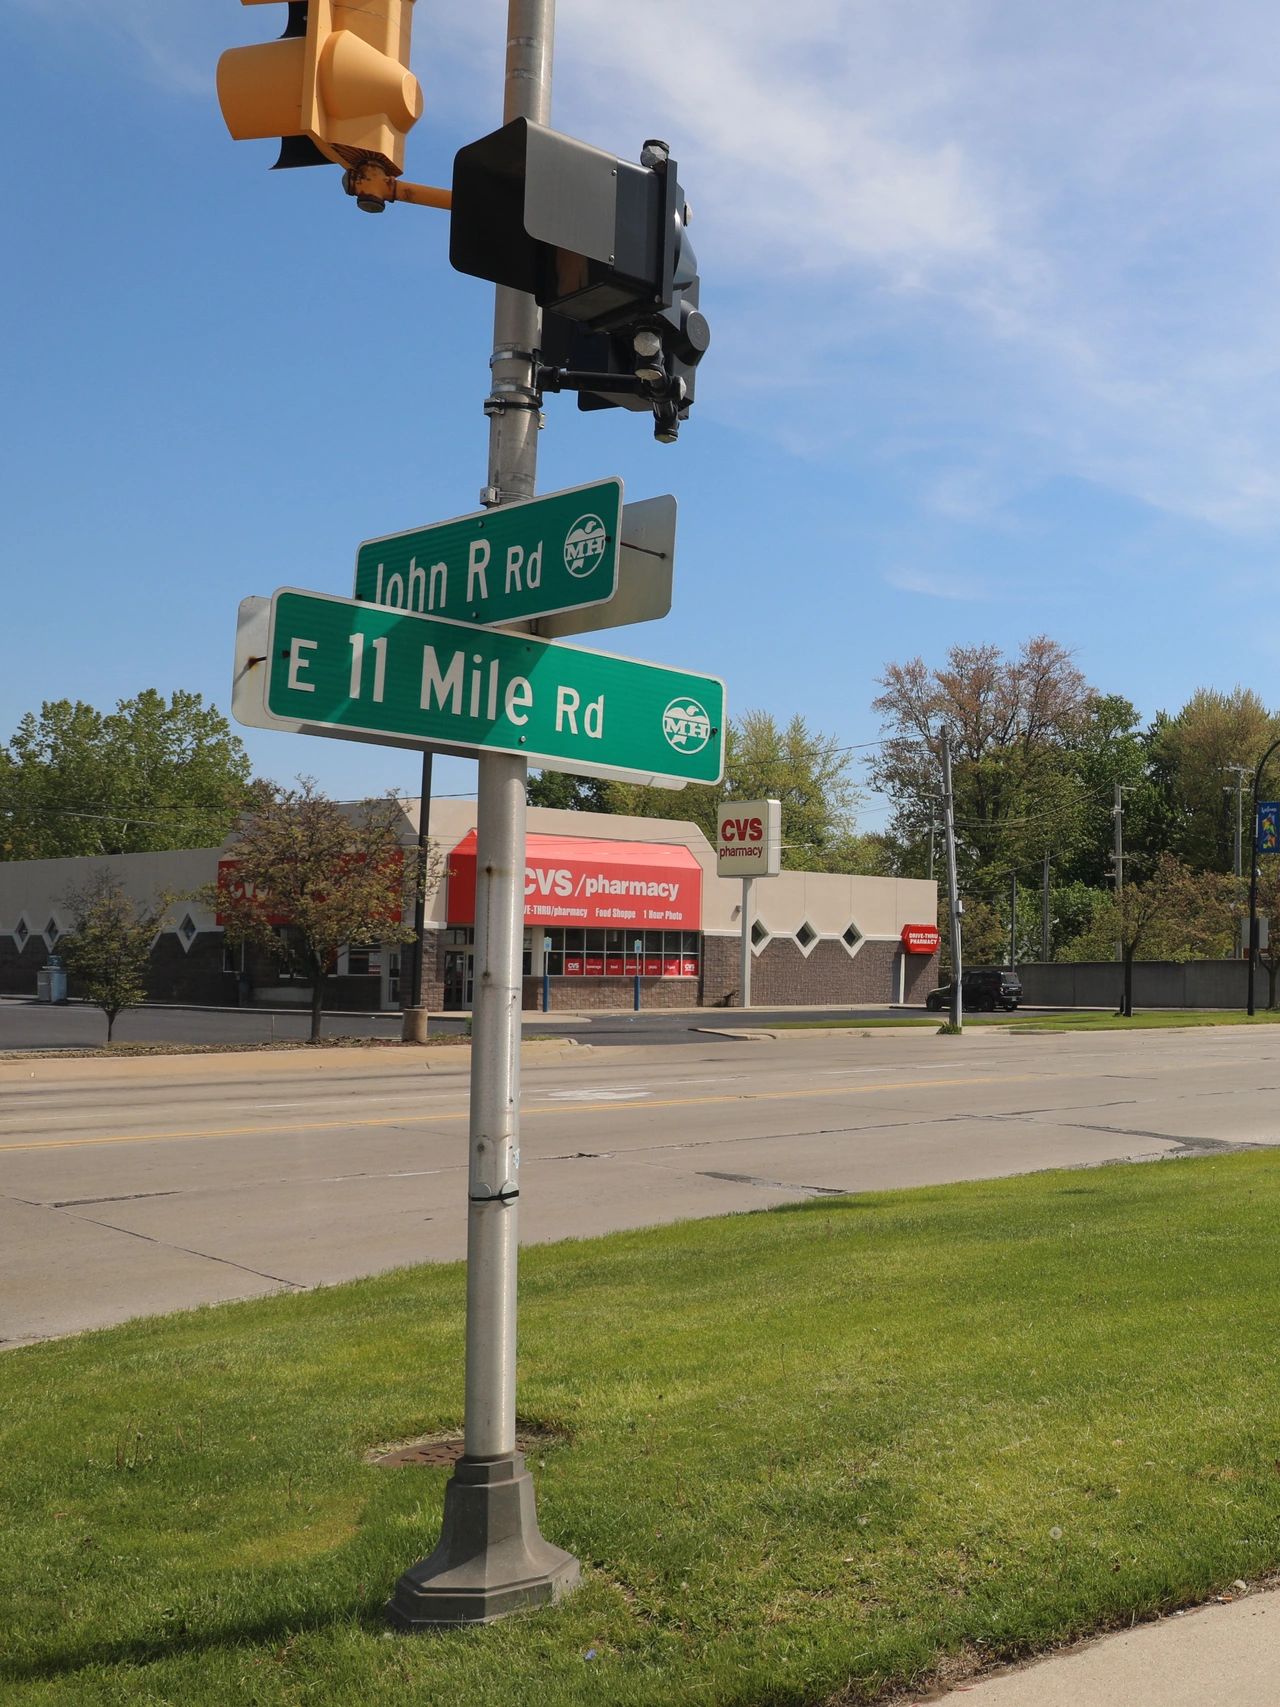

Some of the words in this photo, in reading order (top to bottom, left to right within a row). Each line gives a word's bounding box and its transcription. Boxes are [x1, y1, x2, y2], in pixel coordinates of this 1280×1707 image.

[375, 556, 448, 612] John
[466, 539, 491, 602] R
[504, 540, 543, 594] Rd
[288, 637, 318, 692] E
[349, 633, 388, 703] 11
[419, 644, 533, 726] Mile
[555, 685, 604, 739] Rd
[721, 817, 763, 842] CVS
[719, 846, 763, 861] pharmacy
[595, 907, 611, 918] Food
[612, 908, 636, 919] Shoppe
[649, 910, 664, 919] Hour
[665, 910, 682, 920] Photo
